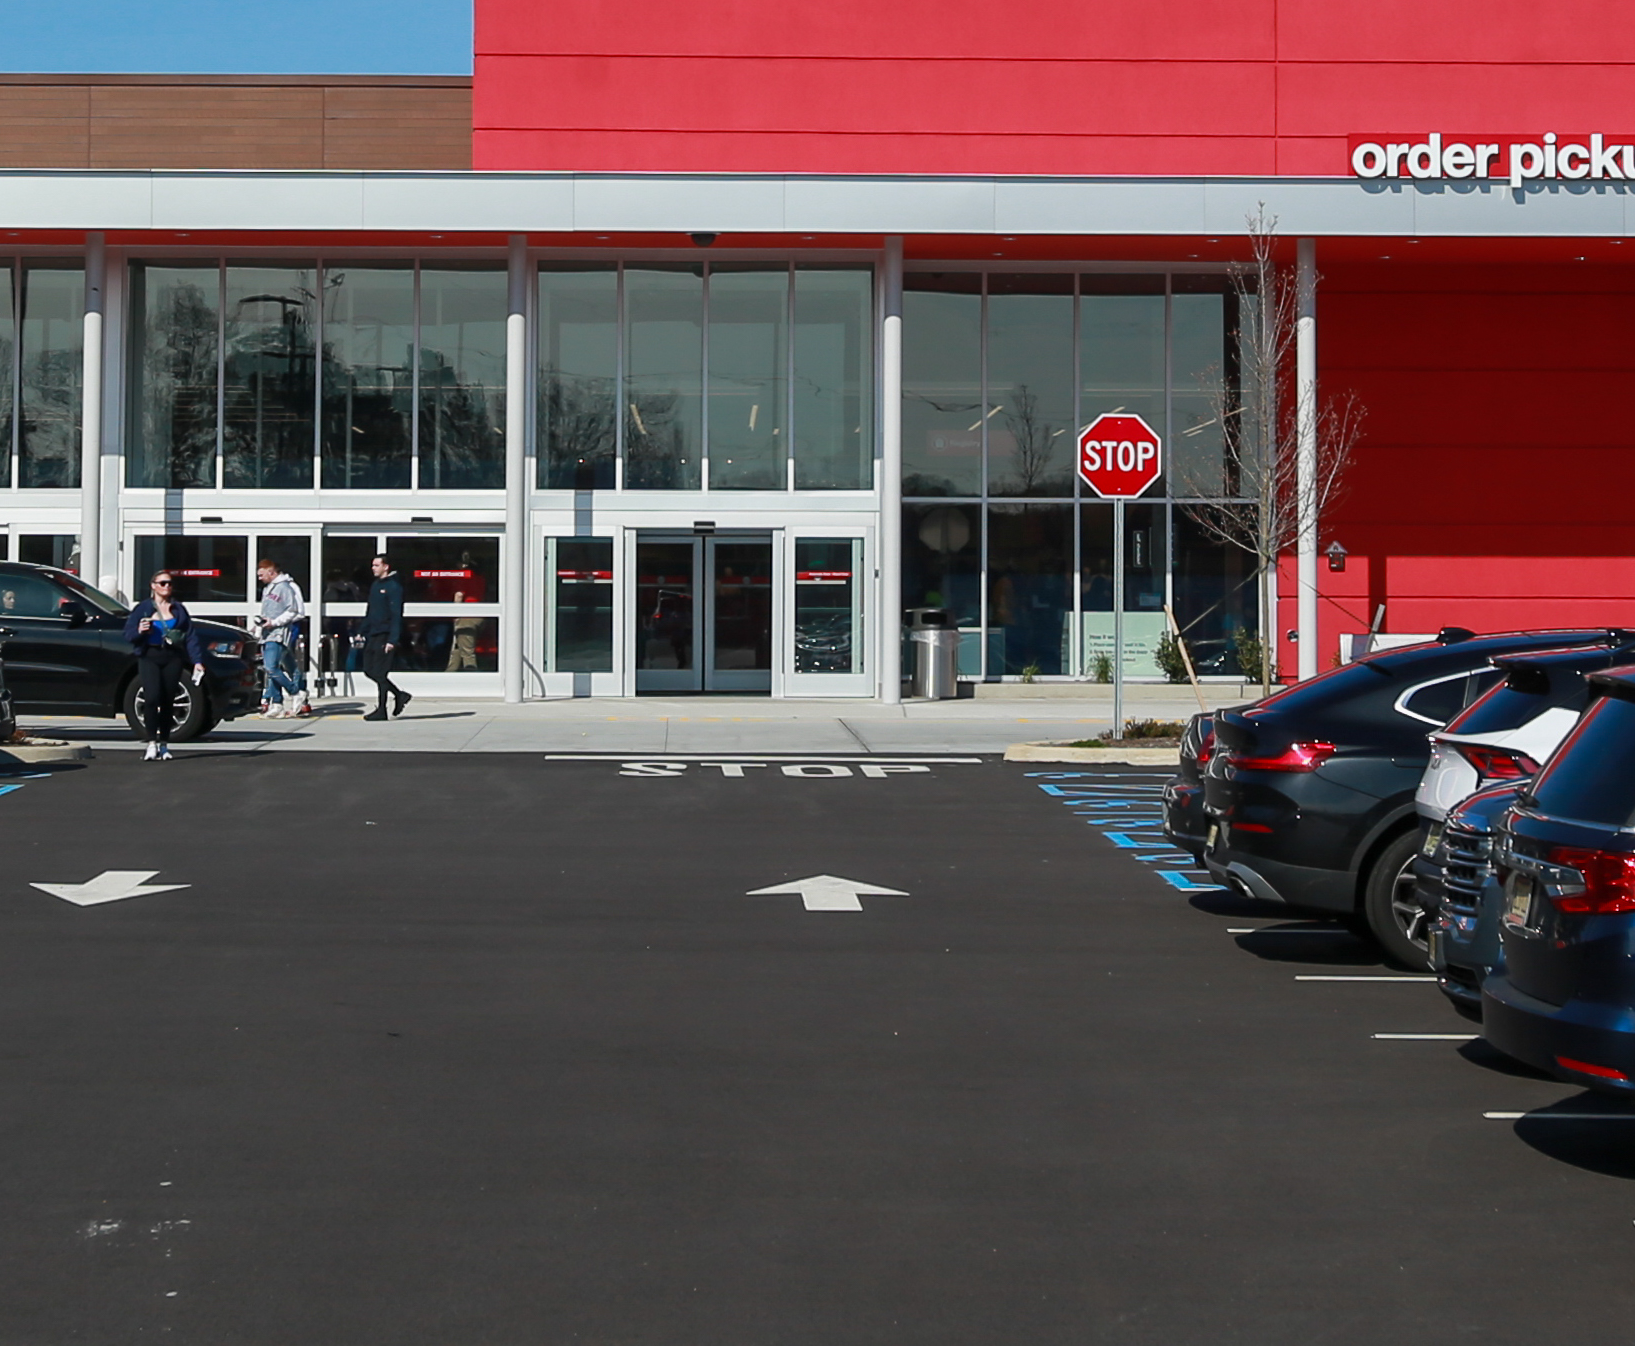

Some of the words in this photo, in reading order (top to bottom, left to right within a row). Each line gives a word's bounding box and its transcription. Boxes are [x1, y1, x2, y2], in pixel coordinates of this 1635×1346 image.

[1352, 133, 1499, 178] order
[1083, 440, 1155, 472] STOP
[618, 762, 931, 778] STOP
